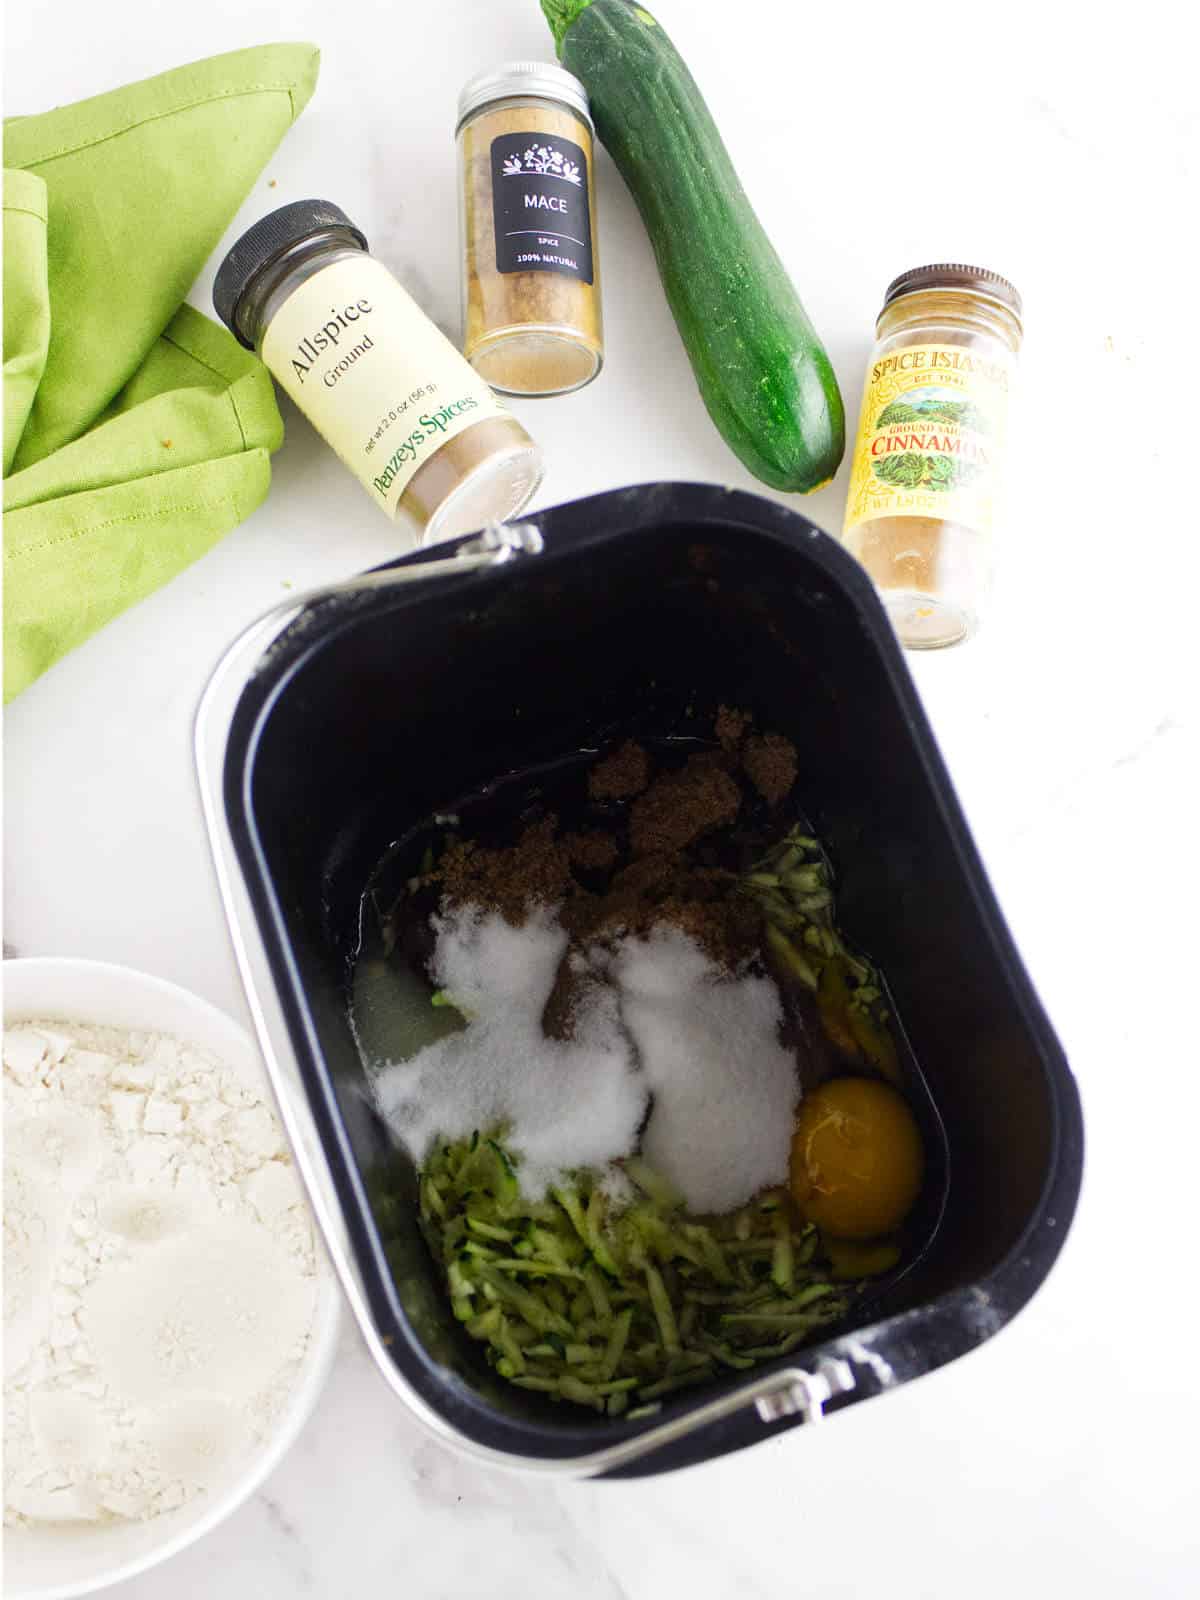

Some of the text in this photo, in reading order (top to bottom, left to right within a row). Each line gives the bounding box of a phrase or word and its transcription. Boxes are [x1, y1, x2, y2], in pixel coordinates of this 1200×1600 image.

[524, 194, 568, 214] MACE
[538, 237, 559, 247] SPICE
[517, 254, 579, 270] 100% NATURAL
[291, 298, 373, 384] Allspice
[322, 334, 375, 388] Ground
[871, 351, 926, 384] SPICE
[365, 437, 377, 455] net
[382, 411, 398, 434] 2.0
[398, 401, 410, 416] oz
[409, 388, 426, 407] (56
[889, 422, 934, 435] GROUND
[373, 396, 478, 498] Penzeys Spices
